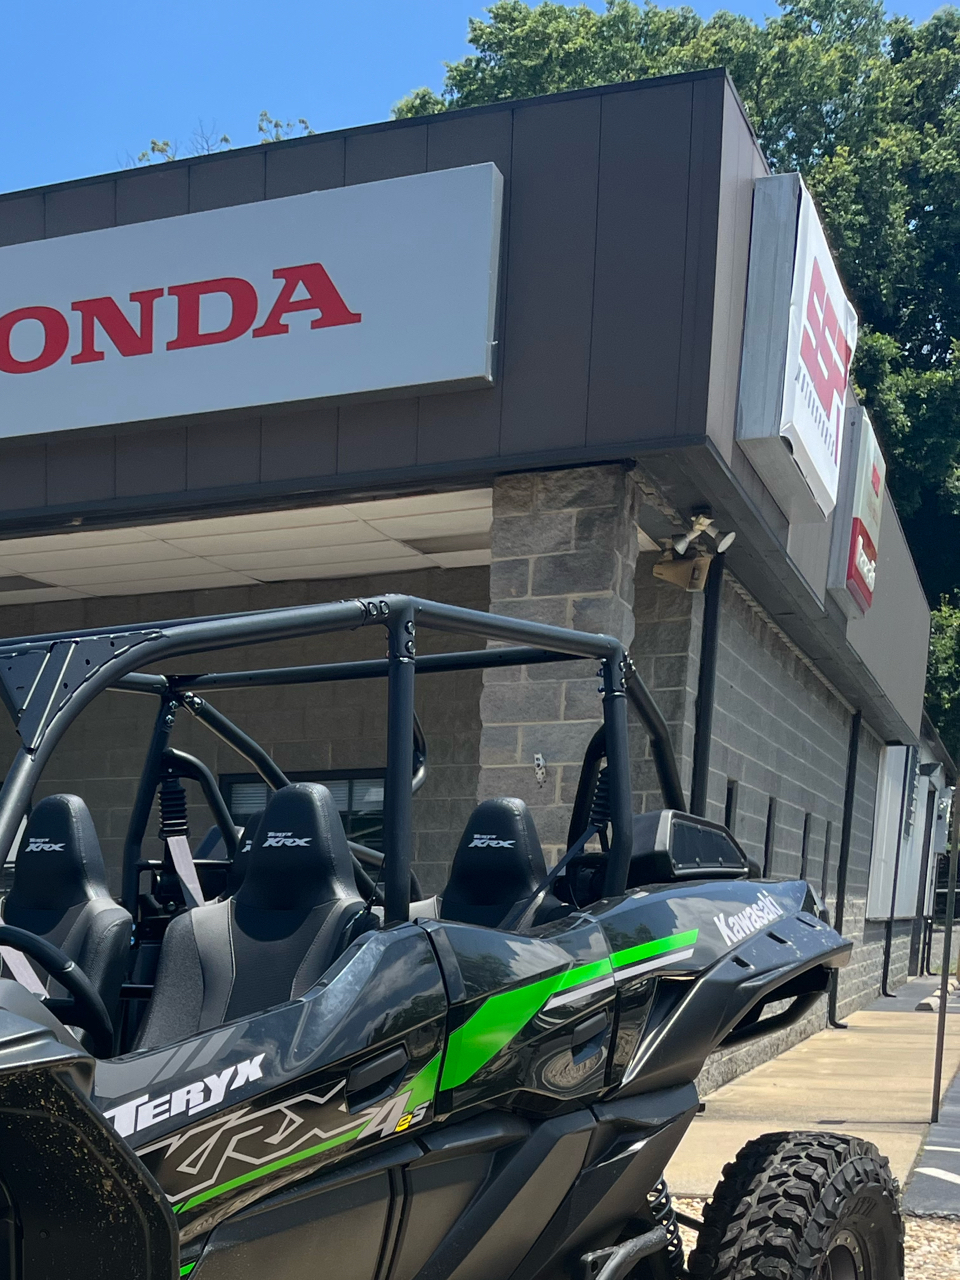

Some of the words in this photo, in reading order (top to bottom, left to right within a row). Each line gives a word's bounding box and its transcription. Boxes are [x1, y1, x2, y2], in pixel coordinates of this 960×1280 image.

[25, 843, 66, 852] KRX
[262, 837, 313, 848] KRX
[467, 839, 517, 848] KRX
[713, 888, 784, 947] Kawasaki
[103, 1052, 266, 1138] TERYX
